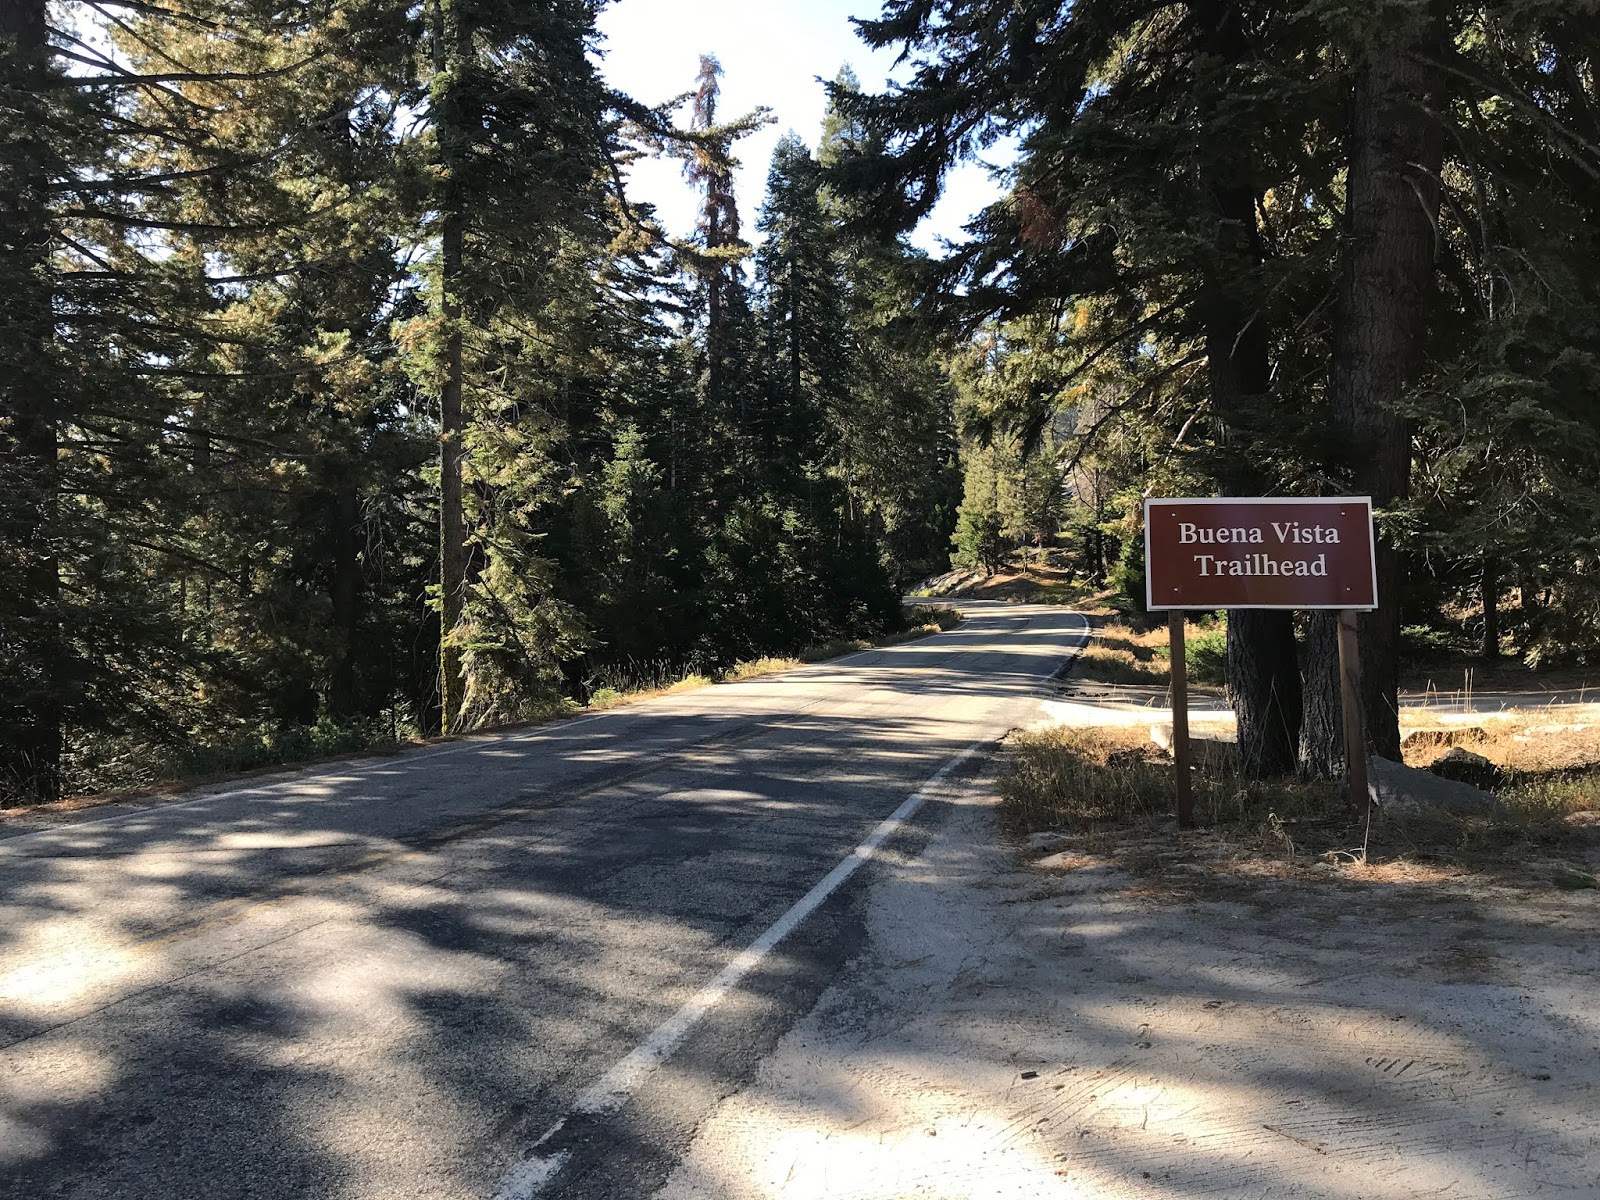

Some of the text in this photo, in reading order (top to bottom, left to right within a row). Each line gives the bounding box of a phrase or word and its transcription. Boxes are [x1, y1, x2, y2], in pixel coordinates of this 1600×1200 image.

[1179, 522, 1340, 543] Buena Vista
[1194, 554, 1327, 576] Trailhead
